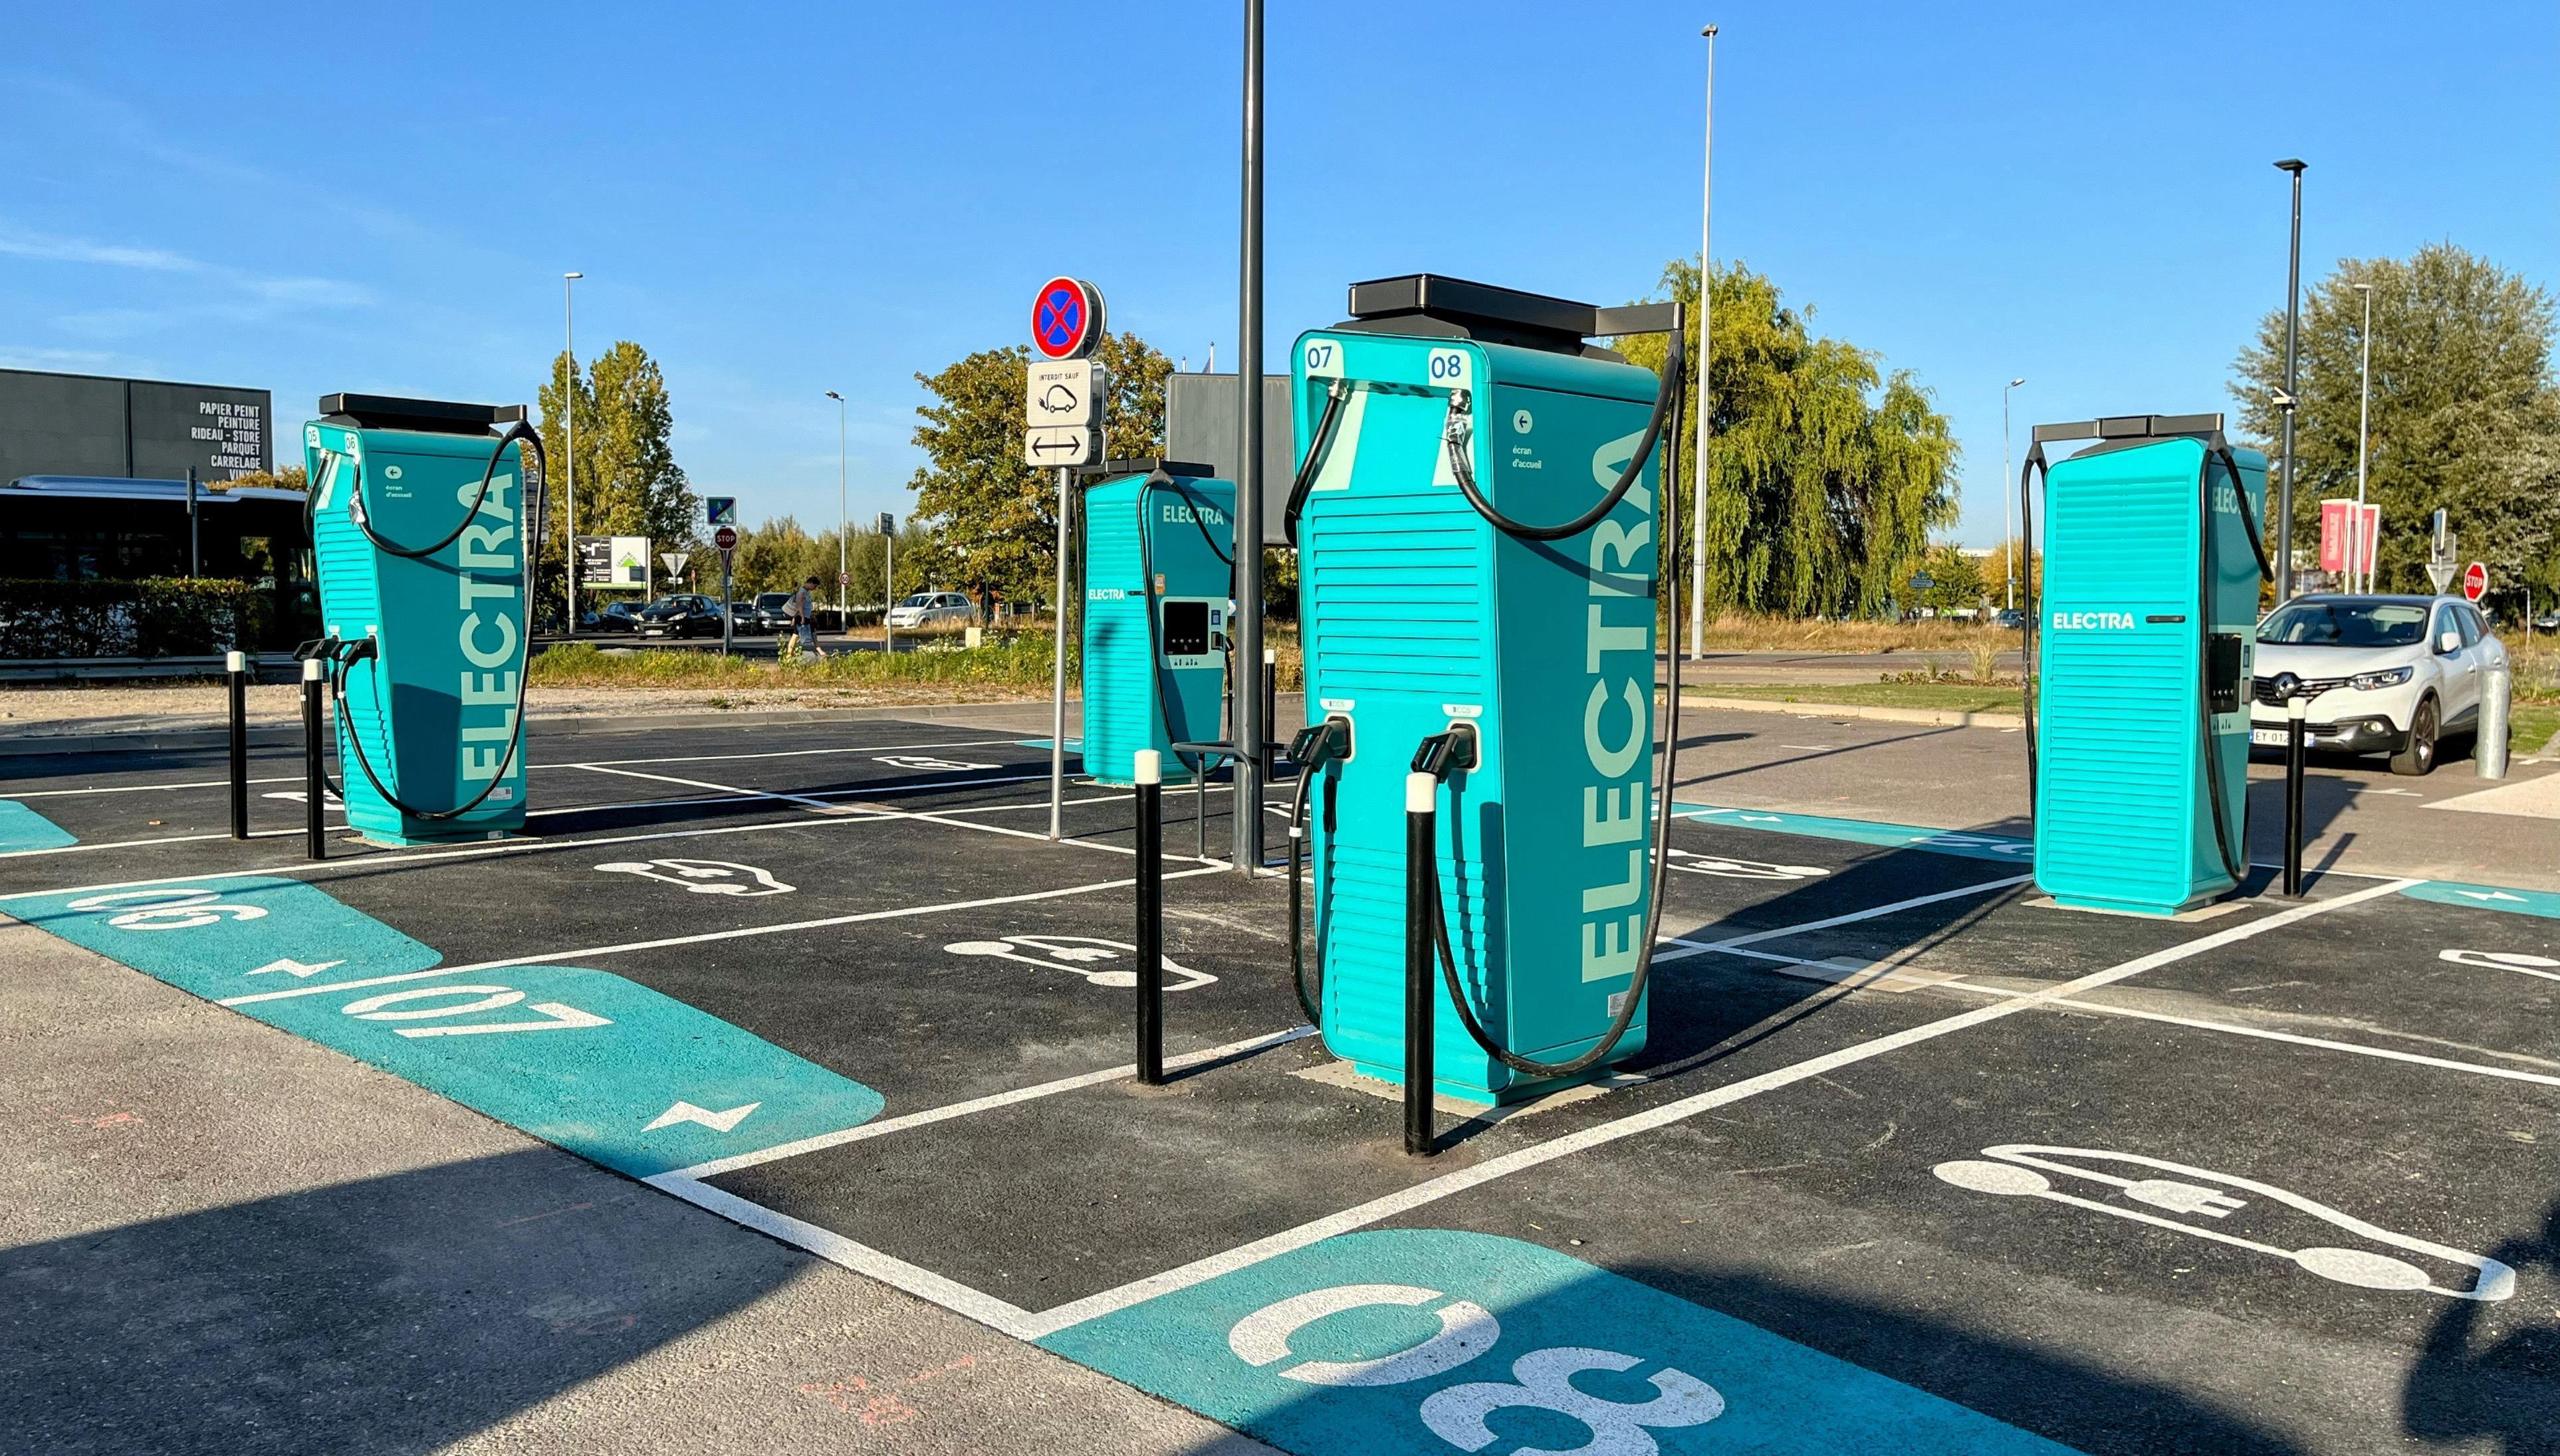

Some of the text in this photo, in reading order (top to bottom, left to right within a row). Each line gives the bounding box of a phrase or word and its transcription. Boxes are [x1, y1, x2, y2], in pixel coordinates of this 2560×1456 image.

[1308, 346, 1332, 368] 07
[1431, 355, 1461, 378] 08
[200, 402, 260, 417] PAPIER PEINT
[218, 416, 260, 430] PEINTURE
[191, 427, 223, 441] RIDEAU
[233, 431, 260, 443] STORE
[308, 430, 317, 442] 05
[221, 442, 260, 455] PARQUET
[346, 437, 356, 449] 06
[1512, 445, 1532, 455] écran
[211, 455, 261, 468] CARRELAGE
[1512, 459, 1542, 468] d'accueil
[1163, 505, 1224, 525] ELECTRA
[2466, 574, 2483, 589] STOP
[1088, 589, 1125, 600] ELECTRA
[457, 473, 517, 780] ELECTRA
[2053, 612, 2135, 630] ELECTRA
[1581, 427, 1651, 983] ELECTRA
[67, 889, 269, 930] 06
[342, 985, 615, 1038] 07
[1228, 1284, 1725, 1456] 08
